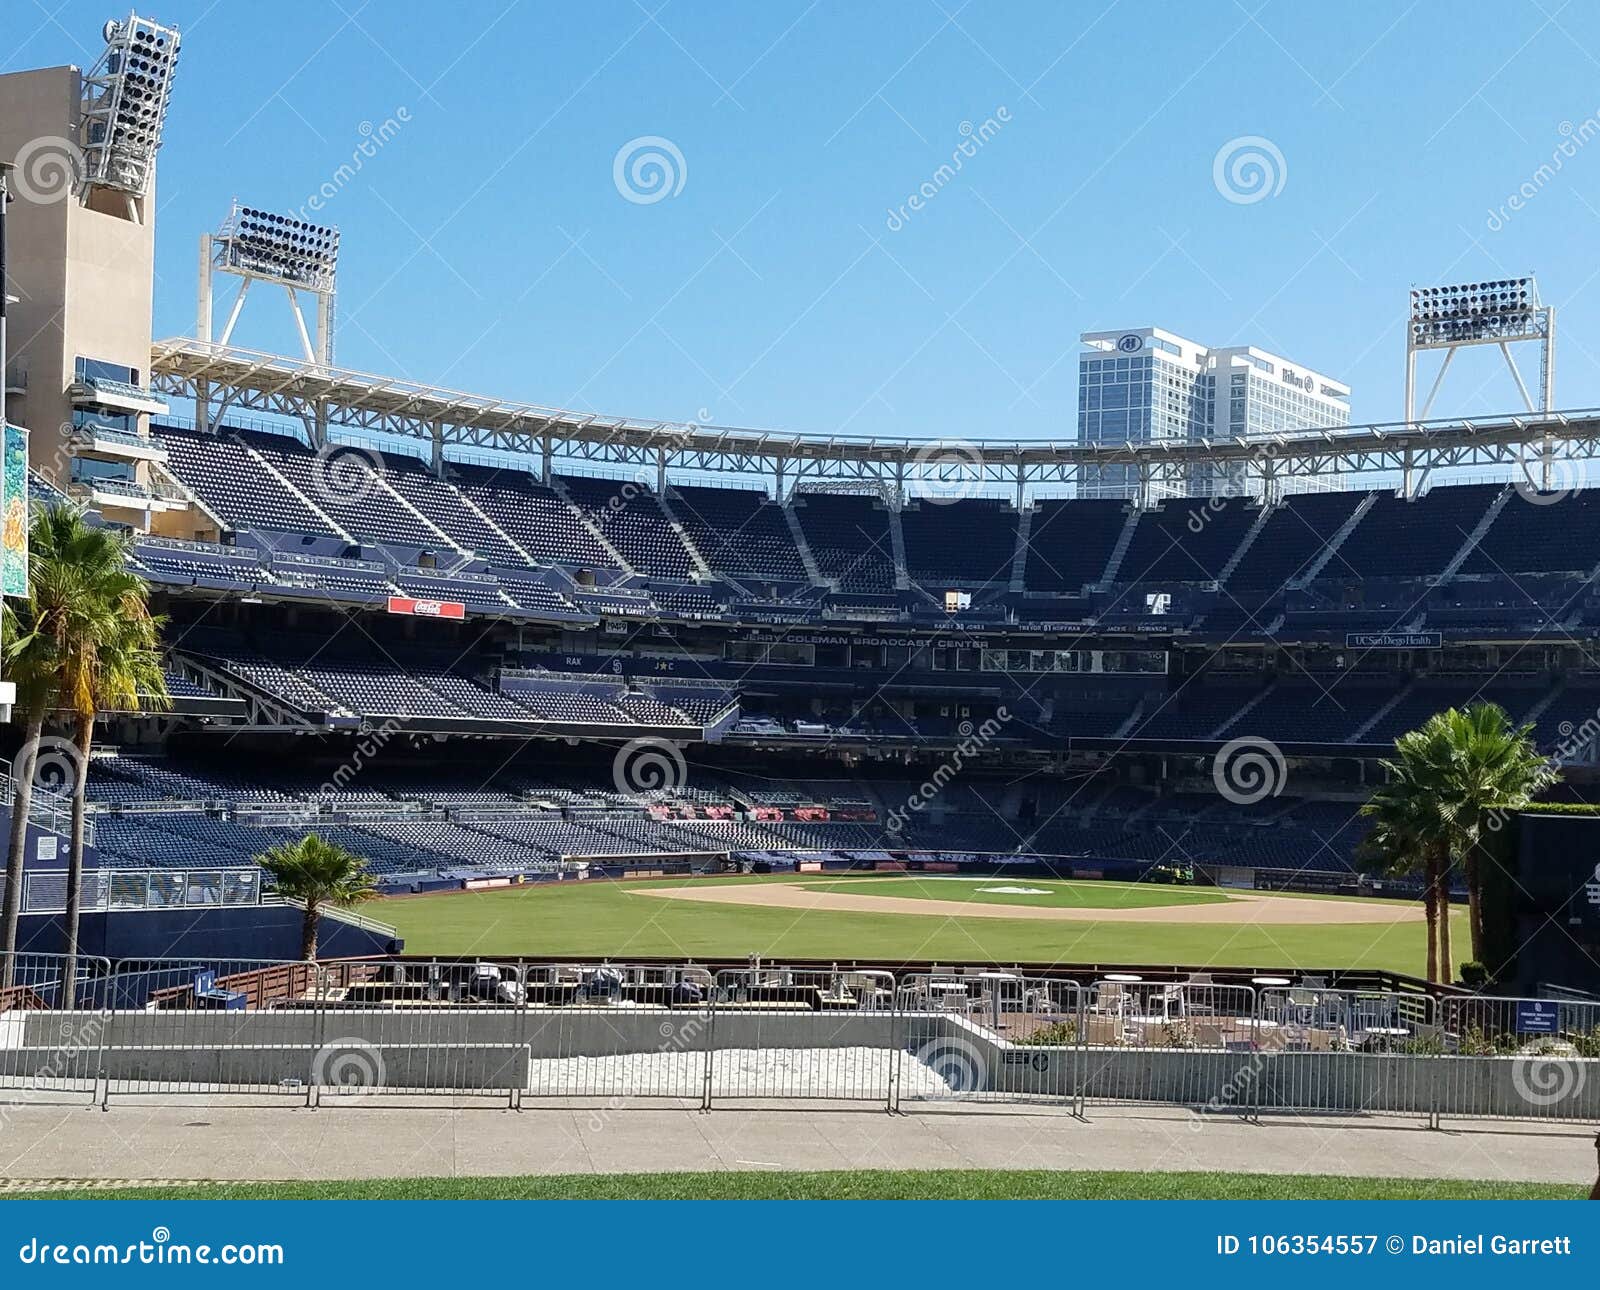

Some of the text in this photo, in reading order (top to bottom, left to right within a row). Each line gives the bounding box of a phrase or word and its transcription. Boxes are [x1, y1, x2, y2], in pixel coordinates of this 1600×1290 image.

[742, 633, 989, 649] JERRY COLEMAN BROADCAST CENTER
